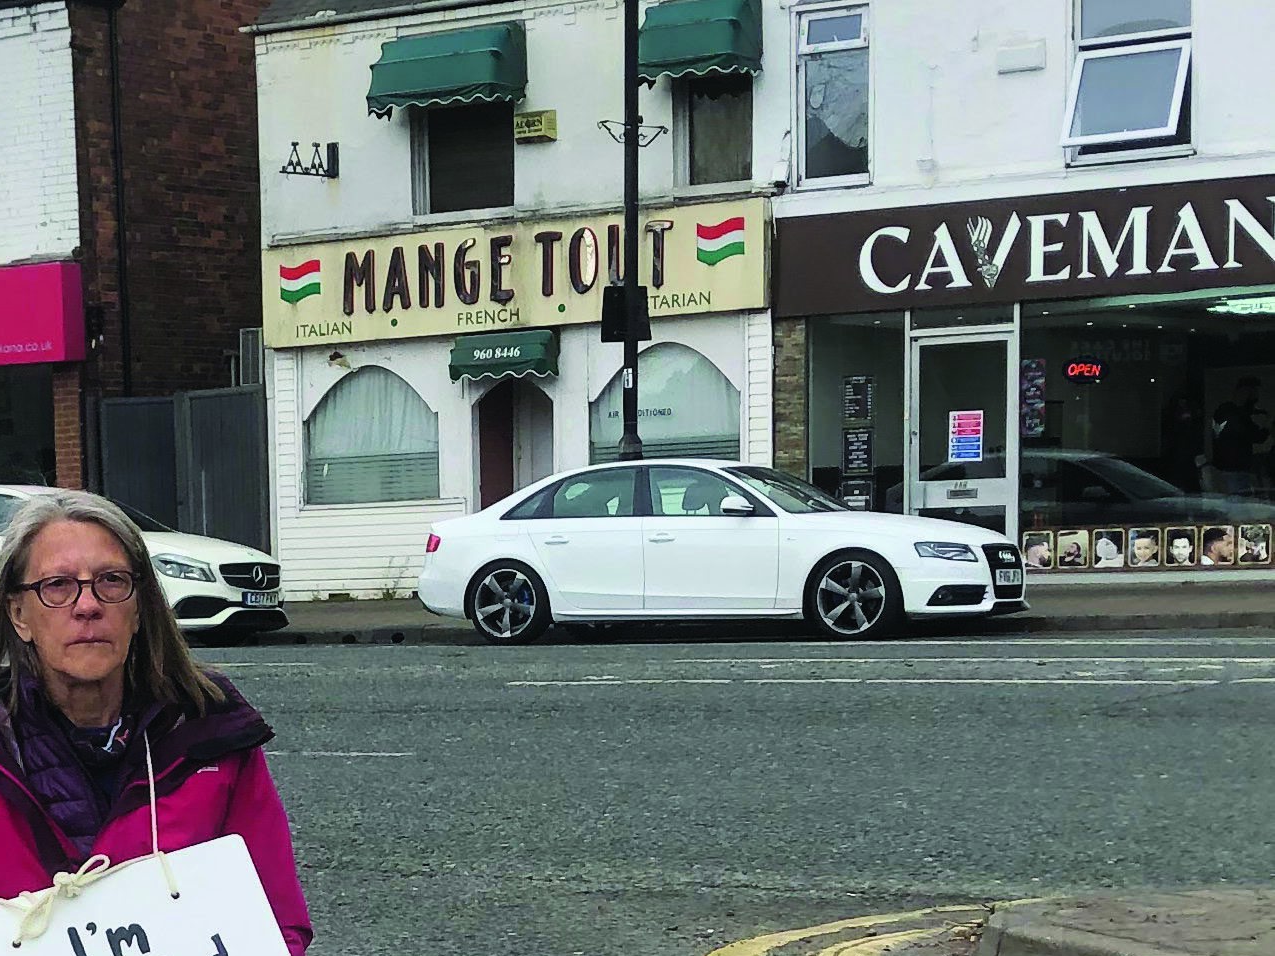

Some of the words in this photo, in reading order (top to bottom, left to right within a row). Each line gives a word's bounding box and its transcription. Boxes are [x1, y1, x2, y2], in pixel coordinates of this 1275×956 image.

[342, 235, 515, 316] MANGE
[296, 321, 353, 338] ITALIAN
[457, 307, 520, 326] FRENCH
[473, 348, 493, 361] 960
[494, 346, 521, 360] 8446
[1067, 363, 1101, 377] OPEN
